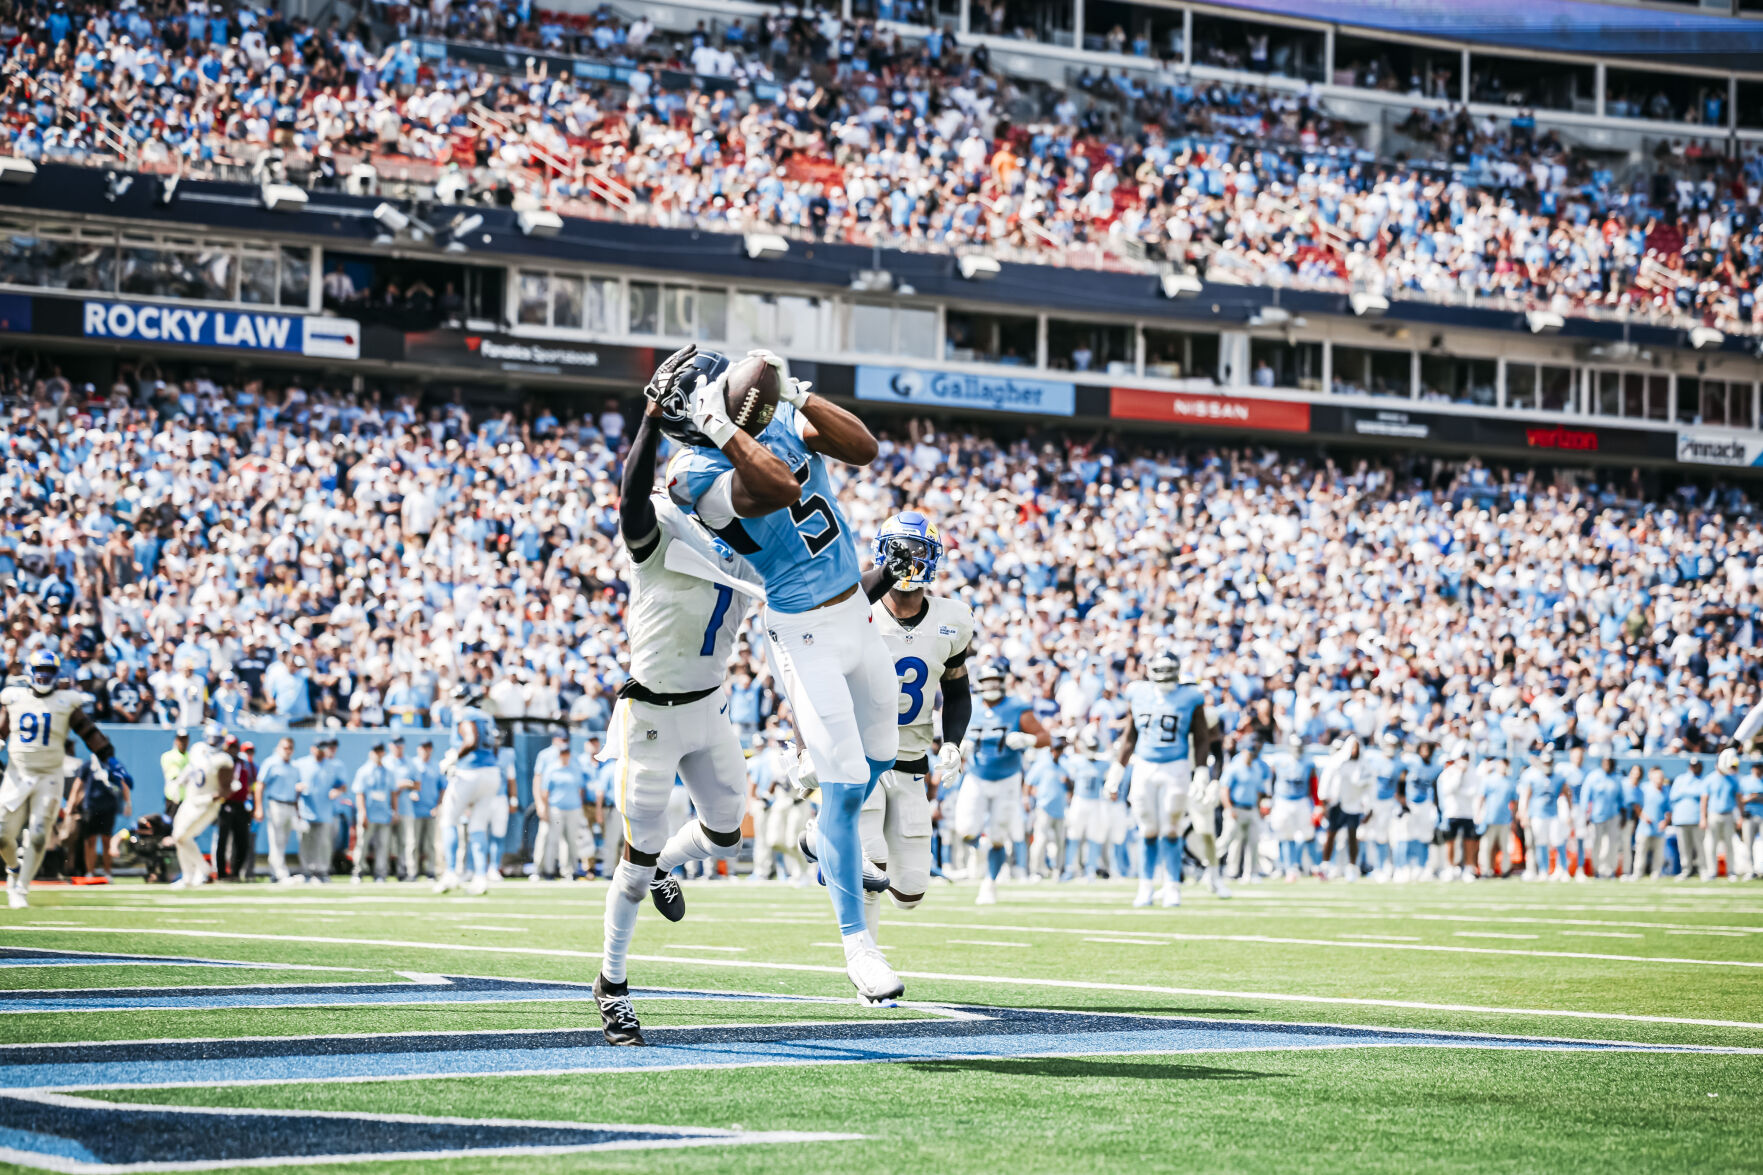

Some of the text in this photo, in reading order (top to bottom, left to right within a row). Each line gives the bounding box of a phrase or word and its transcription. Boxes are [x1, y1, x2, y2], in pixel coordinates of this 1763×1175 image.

[84, 302, 291, 349] ROCKY LAW
[930, 372, 1044, 409] Gallagher
[1173, 399, 1249, 420] NISSAN
[894, 656, 929, 726] 3
[19, 712, 52, 747] 91
